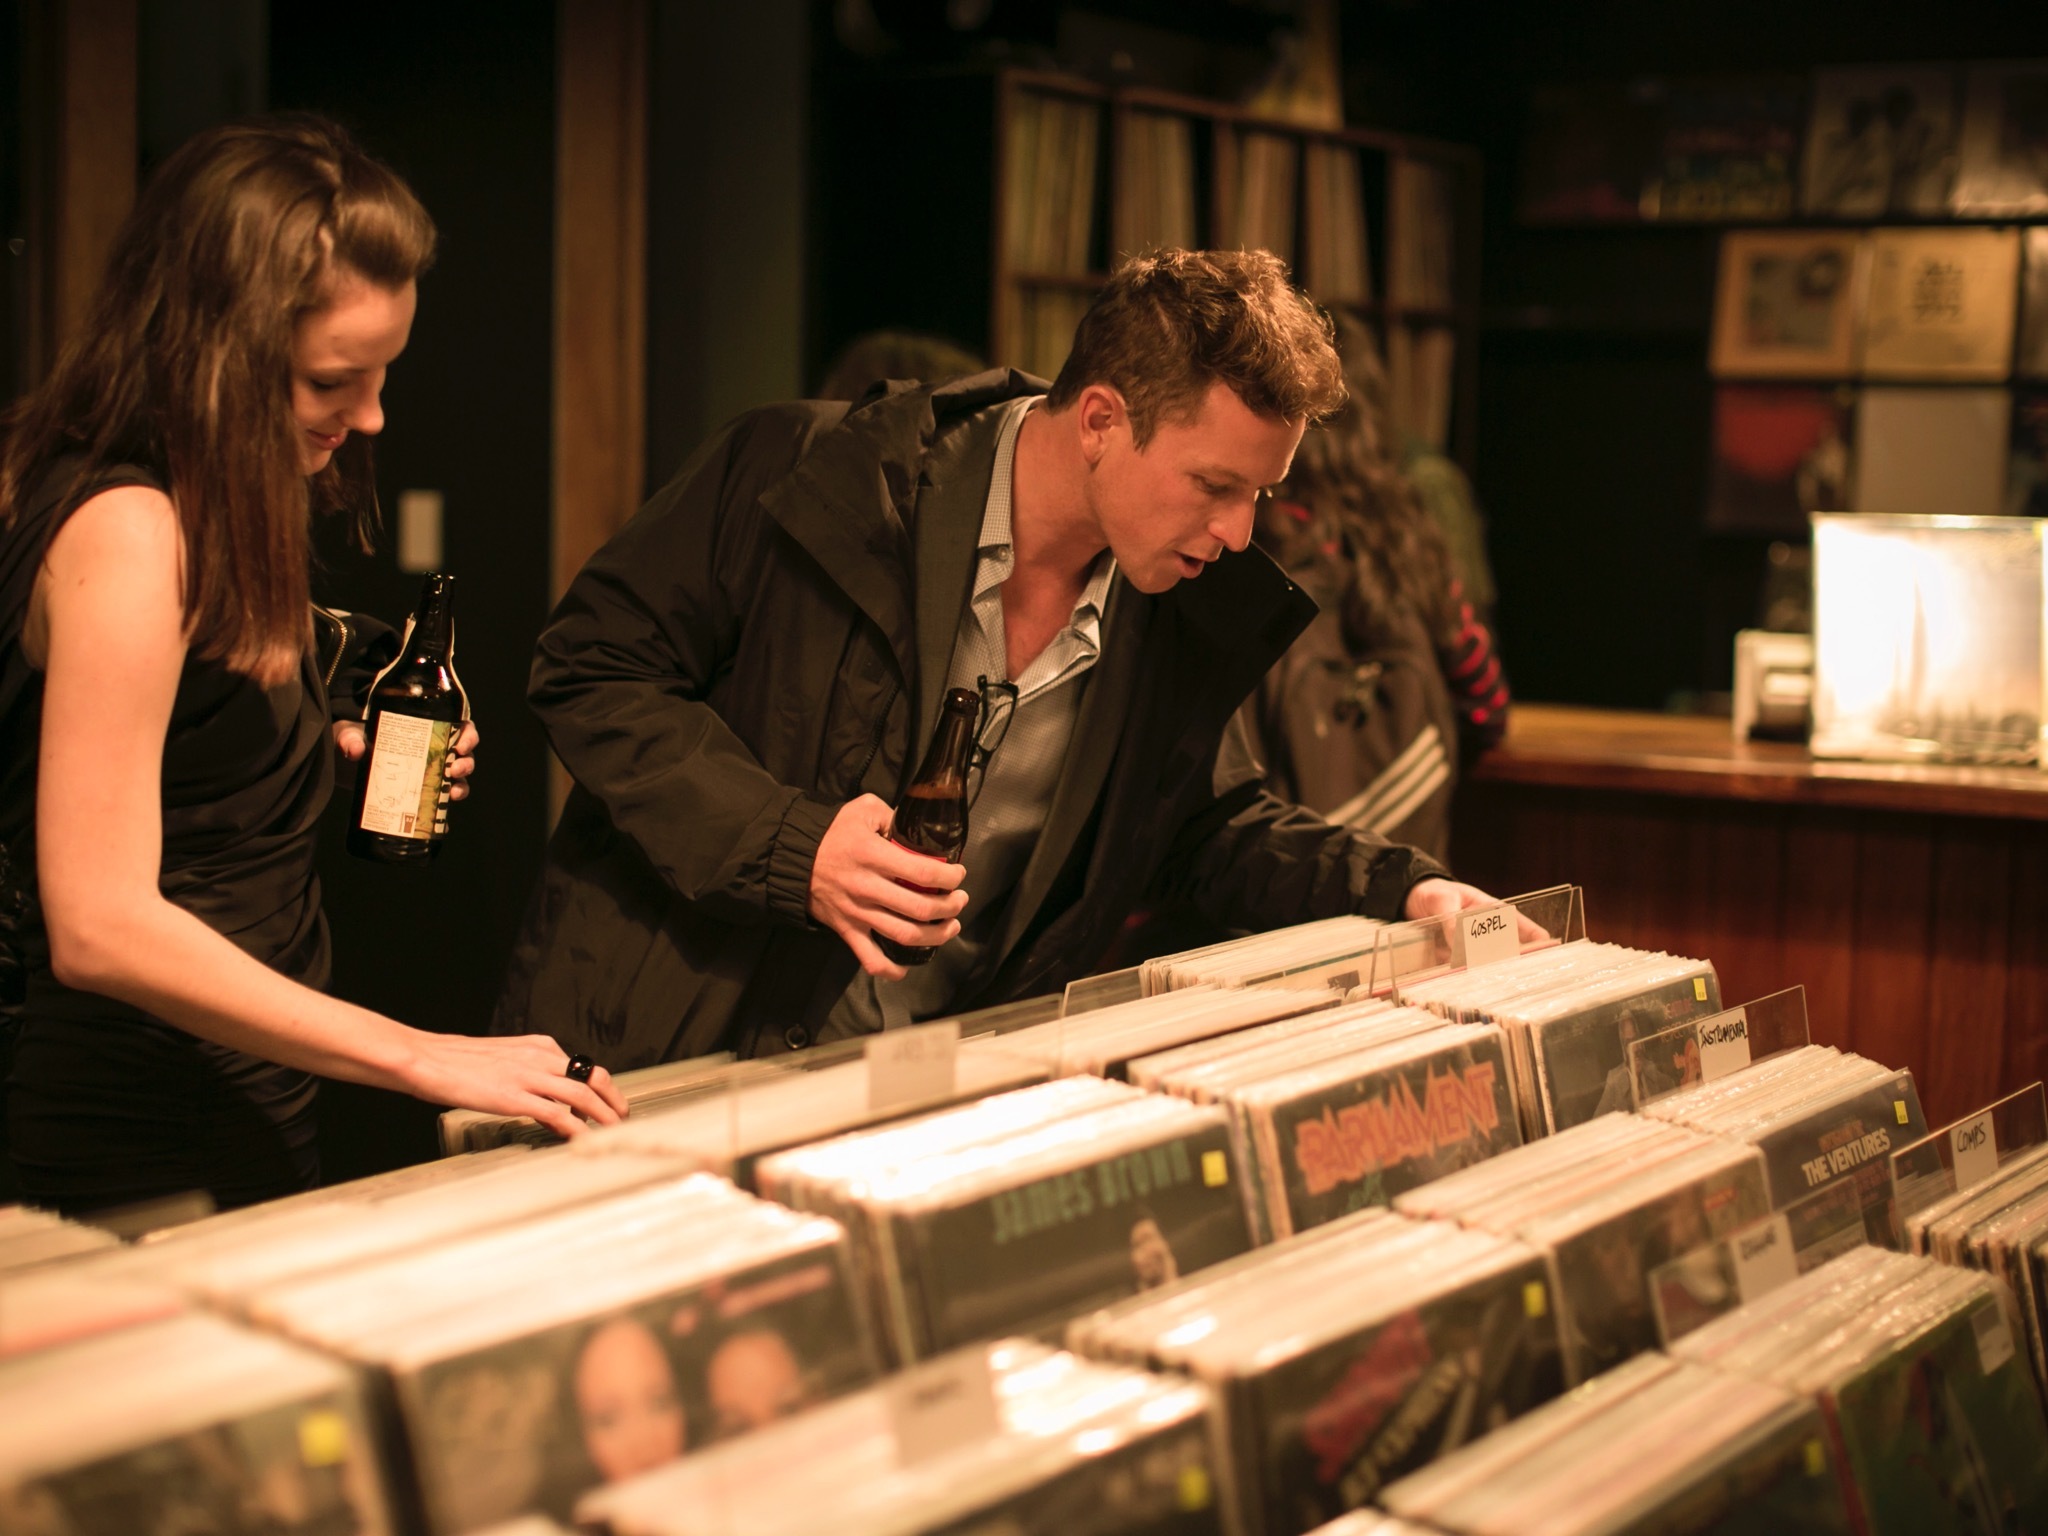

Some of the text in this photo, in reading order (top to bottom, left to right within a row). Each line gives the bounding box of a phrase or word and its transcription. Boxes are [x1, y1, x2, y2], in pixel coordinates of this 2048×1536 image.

[1471, 915, 1507, 938] GOSPEL
[1295, 1060, 1499, 1196] PARLIAMENT
[1957, 1121, 1986, 1152] COMPS
[1801, 1155, 1831, 1187] THE
[1826, 1127, 1891, 1175] VENTURES
